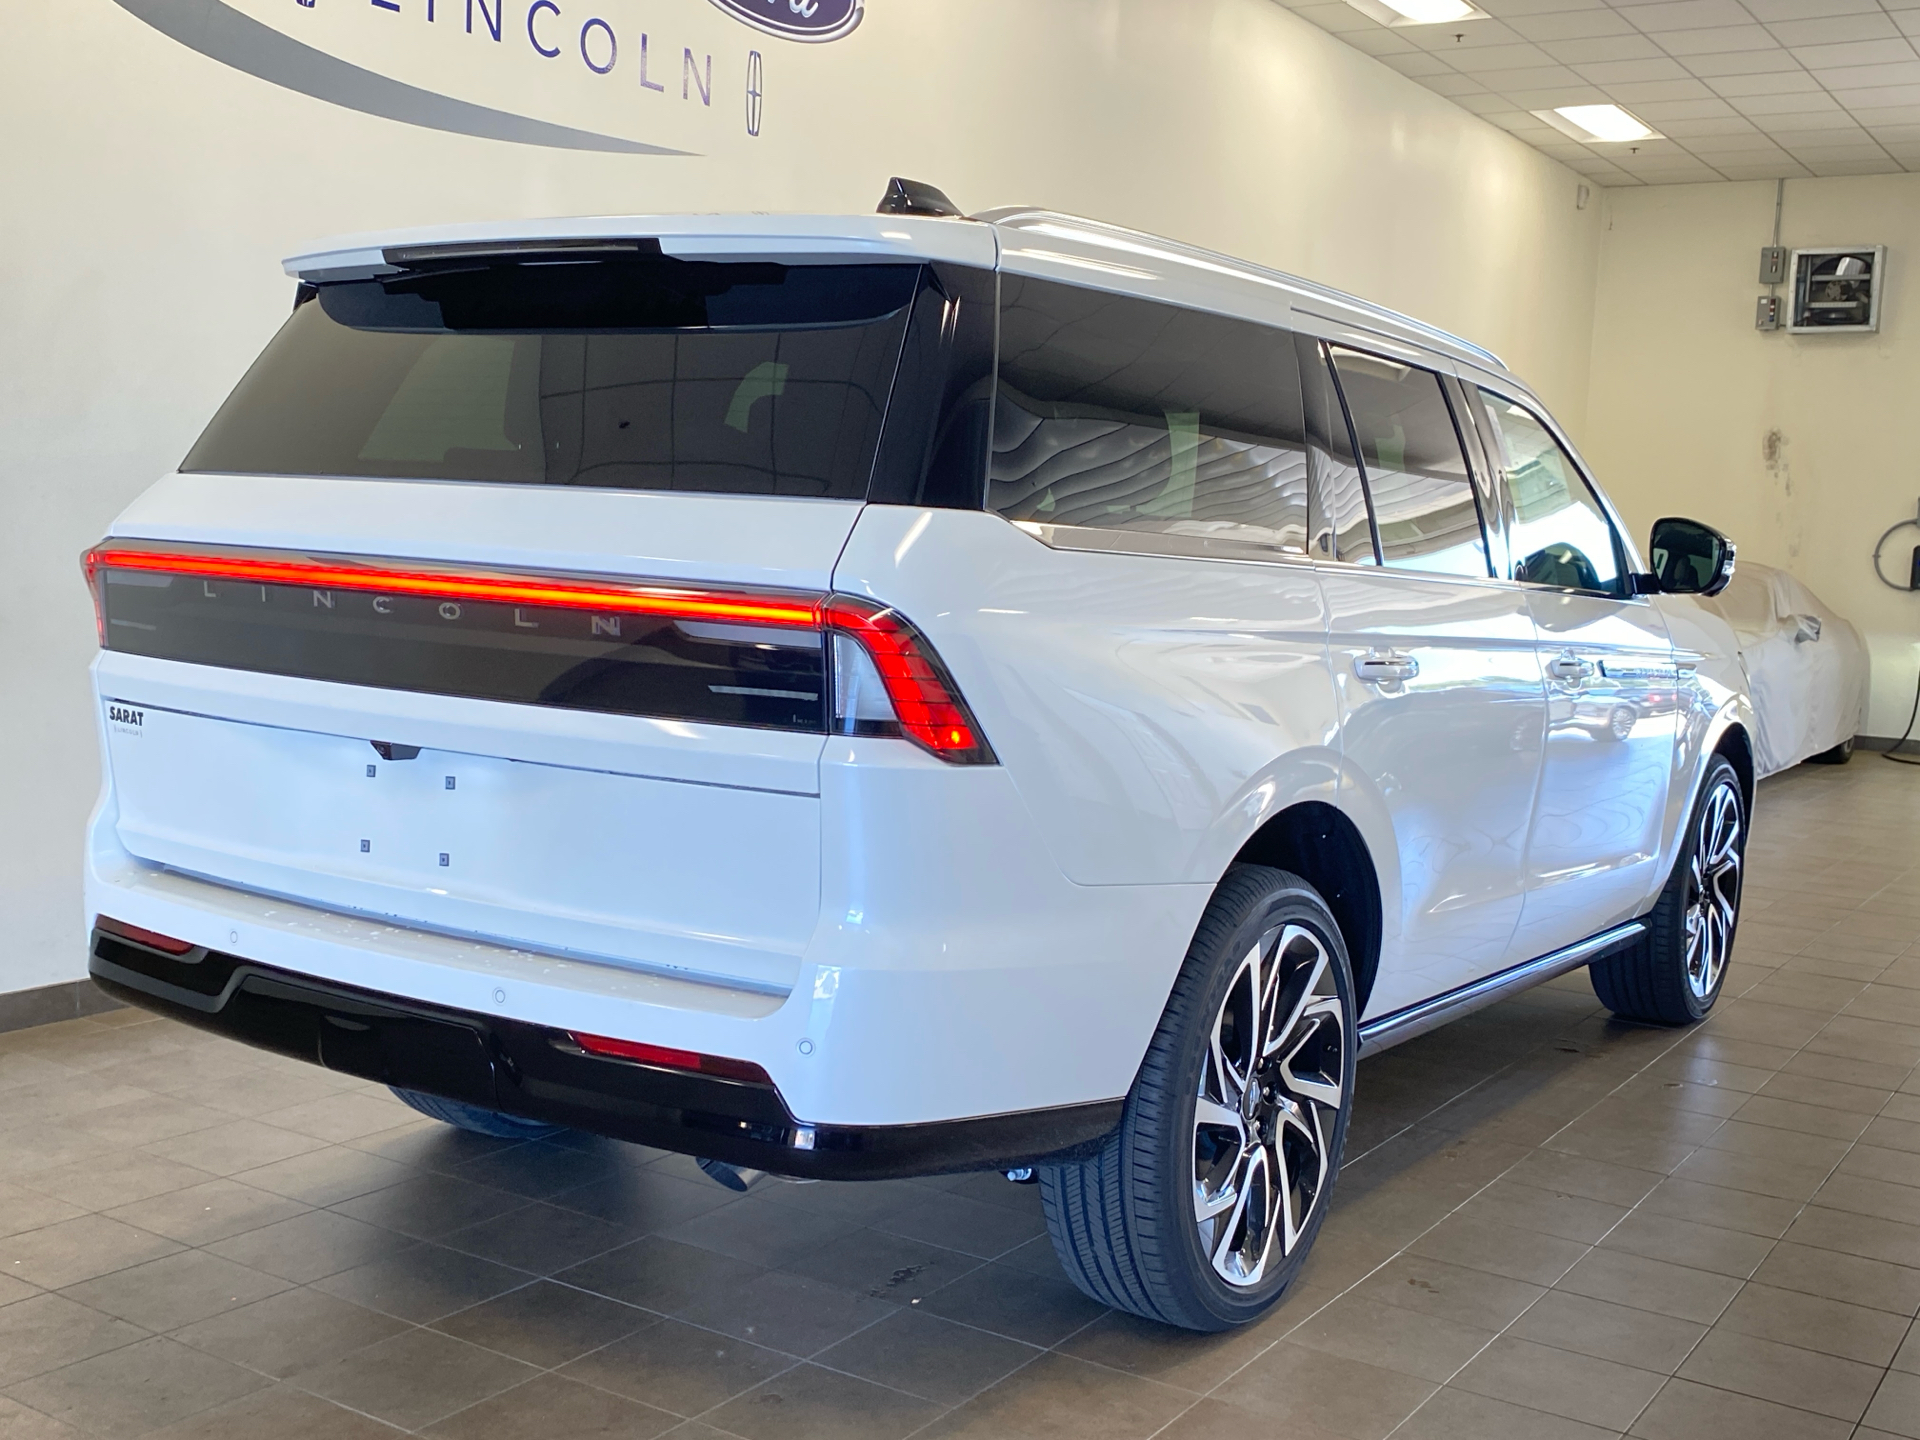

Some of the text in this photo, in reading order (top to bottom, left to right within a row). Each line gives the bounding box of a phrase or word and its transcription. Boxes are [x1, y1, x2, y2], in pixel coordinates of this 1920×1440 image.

[370, 0, 711, 107] NCOLN
[203, 580, 621, 637] LINCOLN
[109, 705, 144, 727] SARAT
